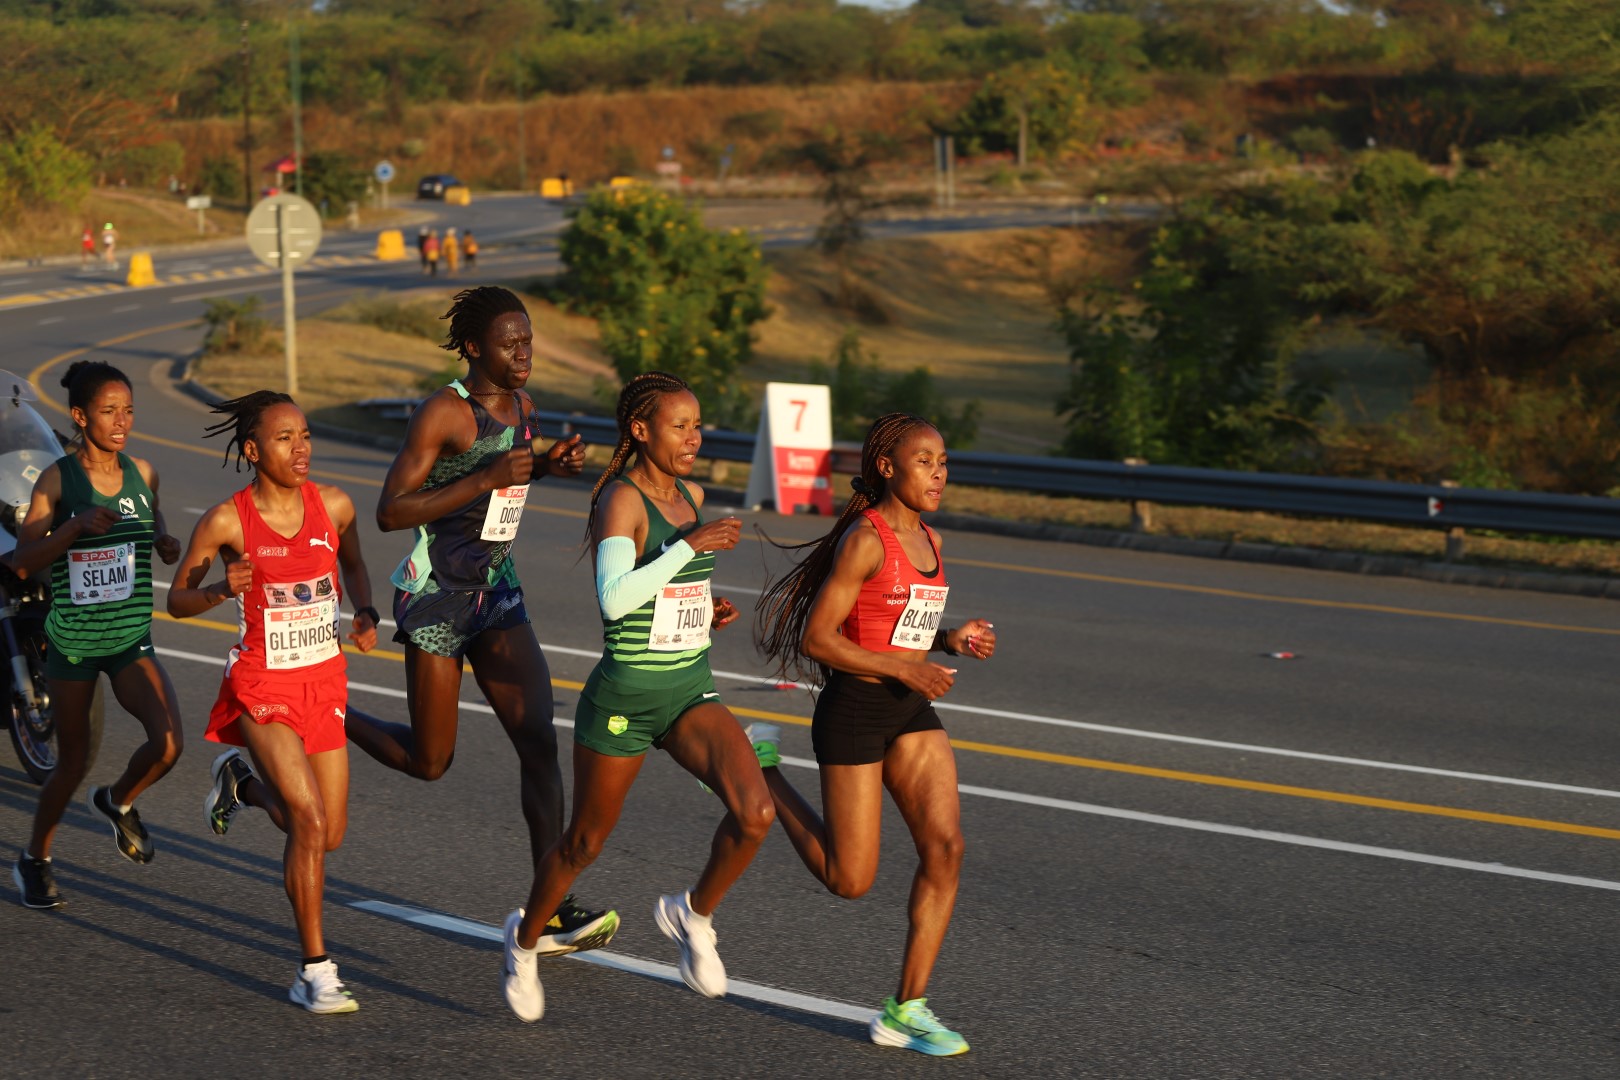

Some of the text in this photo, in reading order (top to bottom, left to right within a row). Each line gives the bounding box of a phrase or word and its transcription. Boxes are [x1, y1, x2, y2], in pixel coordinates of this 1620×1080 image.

[789, 400, 808, 432] 7
[81, 550, 116, 561] SPAR
[82, 565, 128, 588] SELAM
[674, 586, 704, 598] SPAR
[922, 590, 947, 600] SPAR
[281, 606, 320, 621] SPAR
[677, 606, 706, 630] TADU
[269, 620, 339, 651] GLENROSE
